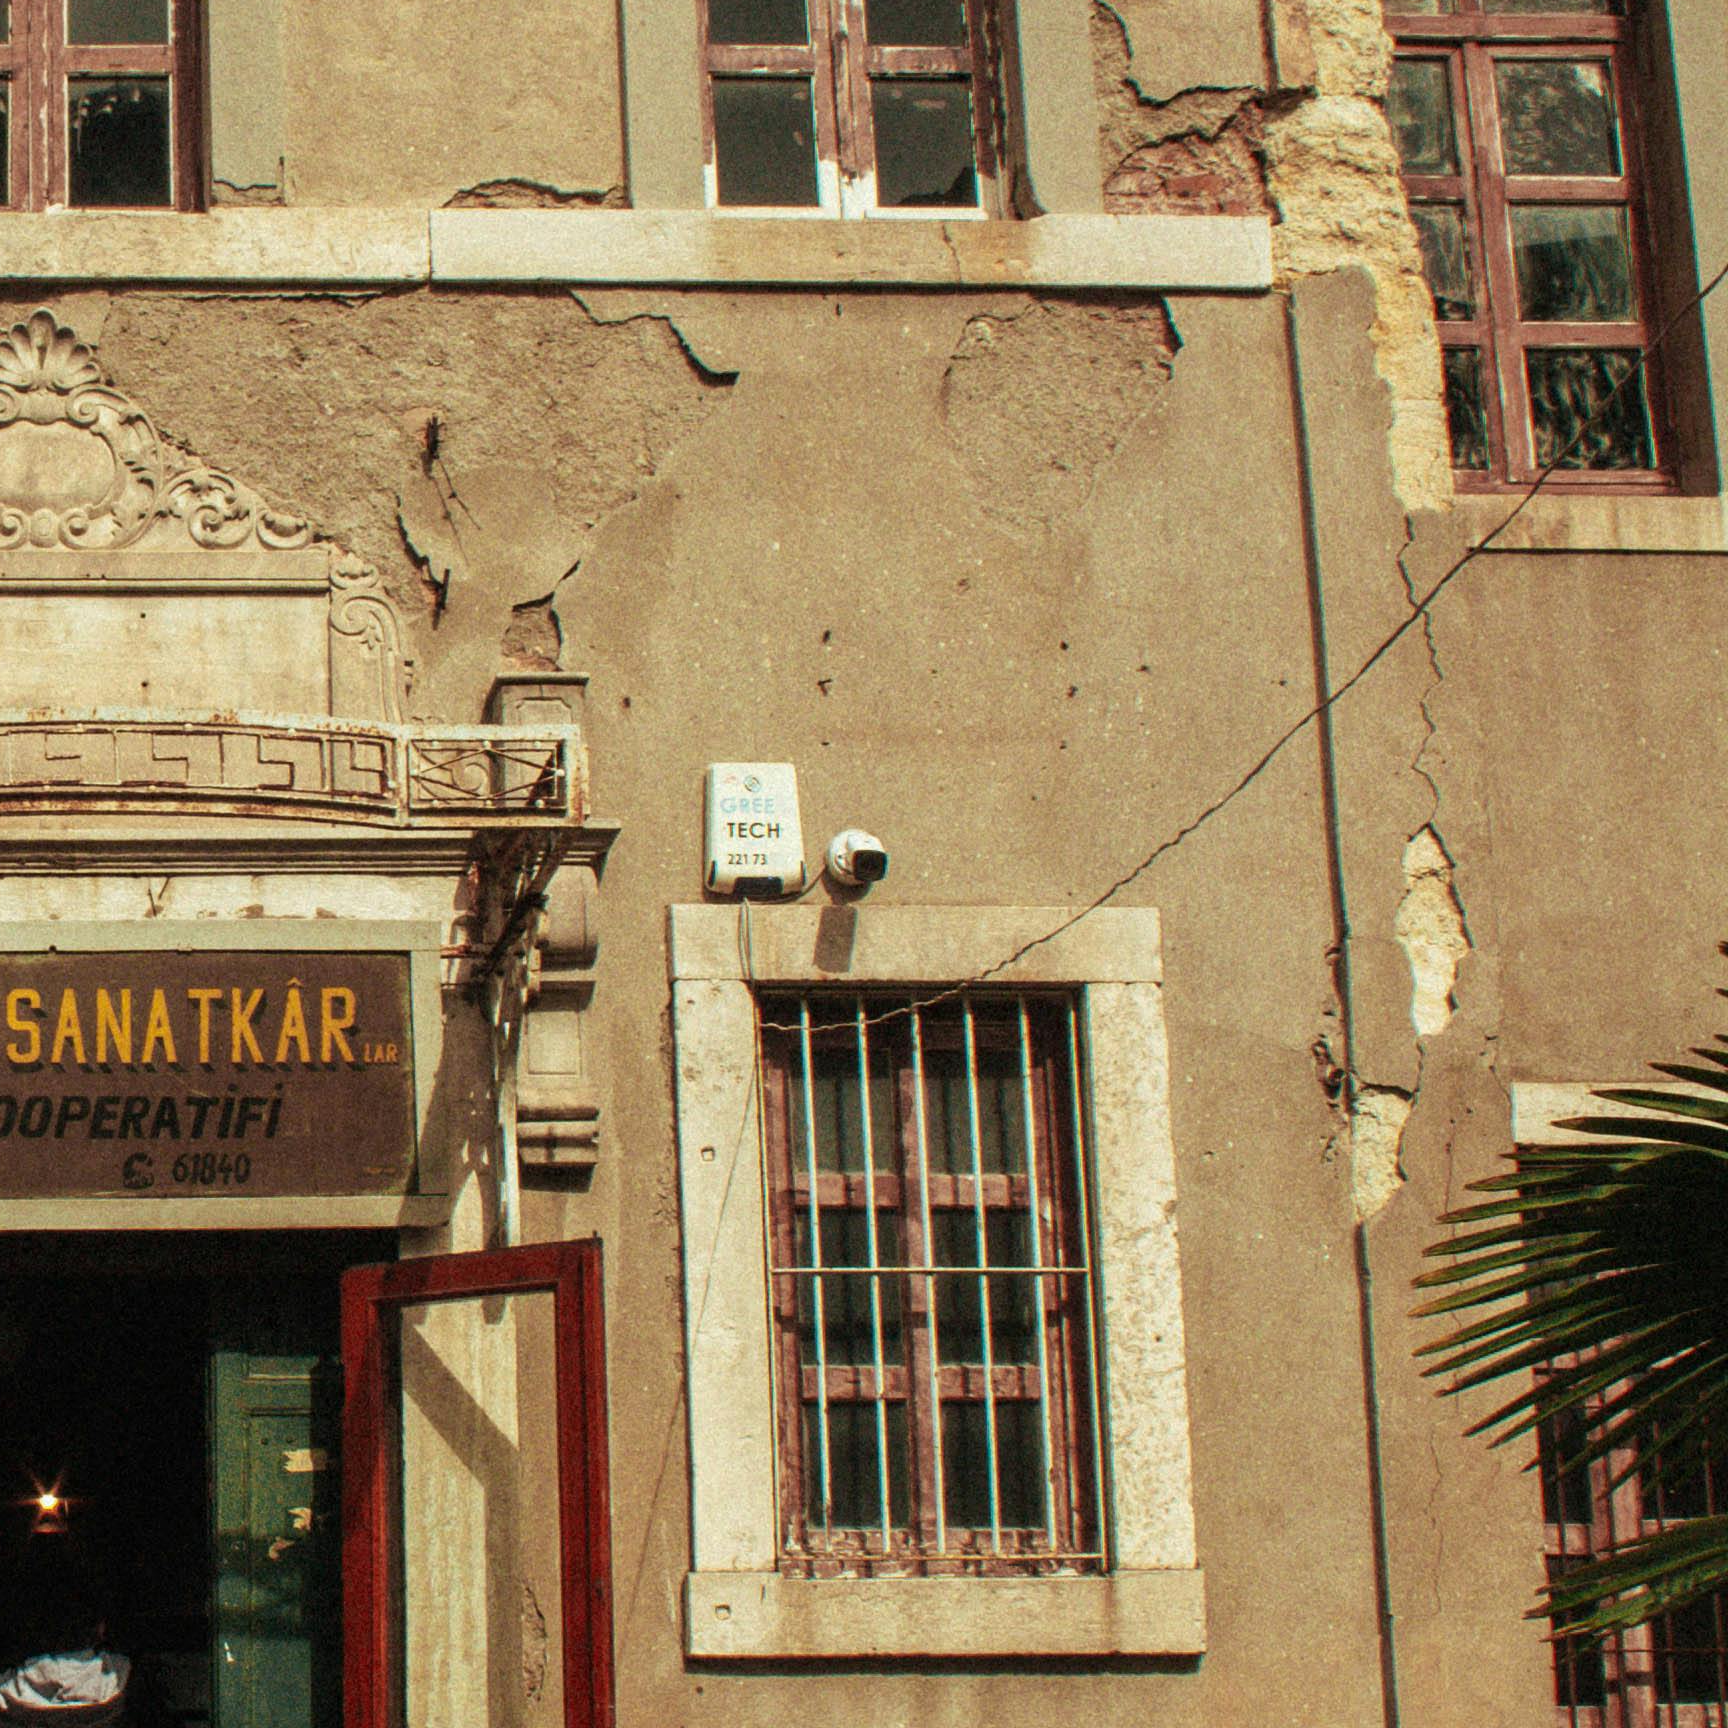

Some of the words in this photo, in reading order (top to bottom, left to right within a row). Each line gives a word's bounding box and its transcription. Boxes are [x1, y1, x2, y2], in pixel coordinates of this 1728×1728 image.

[726, 821, 781, 839] TECH
[5, 976, 357, 1066] SANATKÂR
[364, 1043, 400, 1064] LAR
[172, 1152, 251, 1186] 61840
